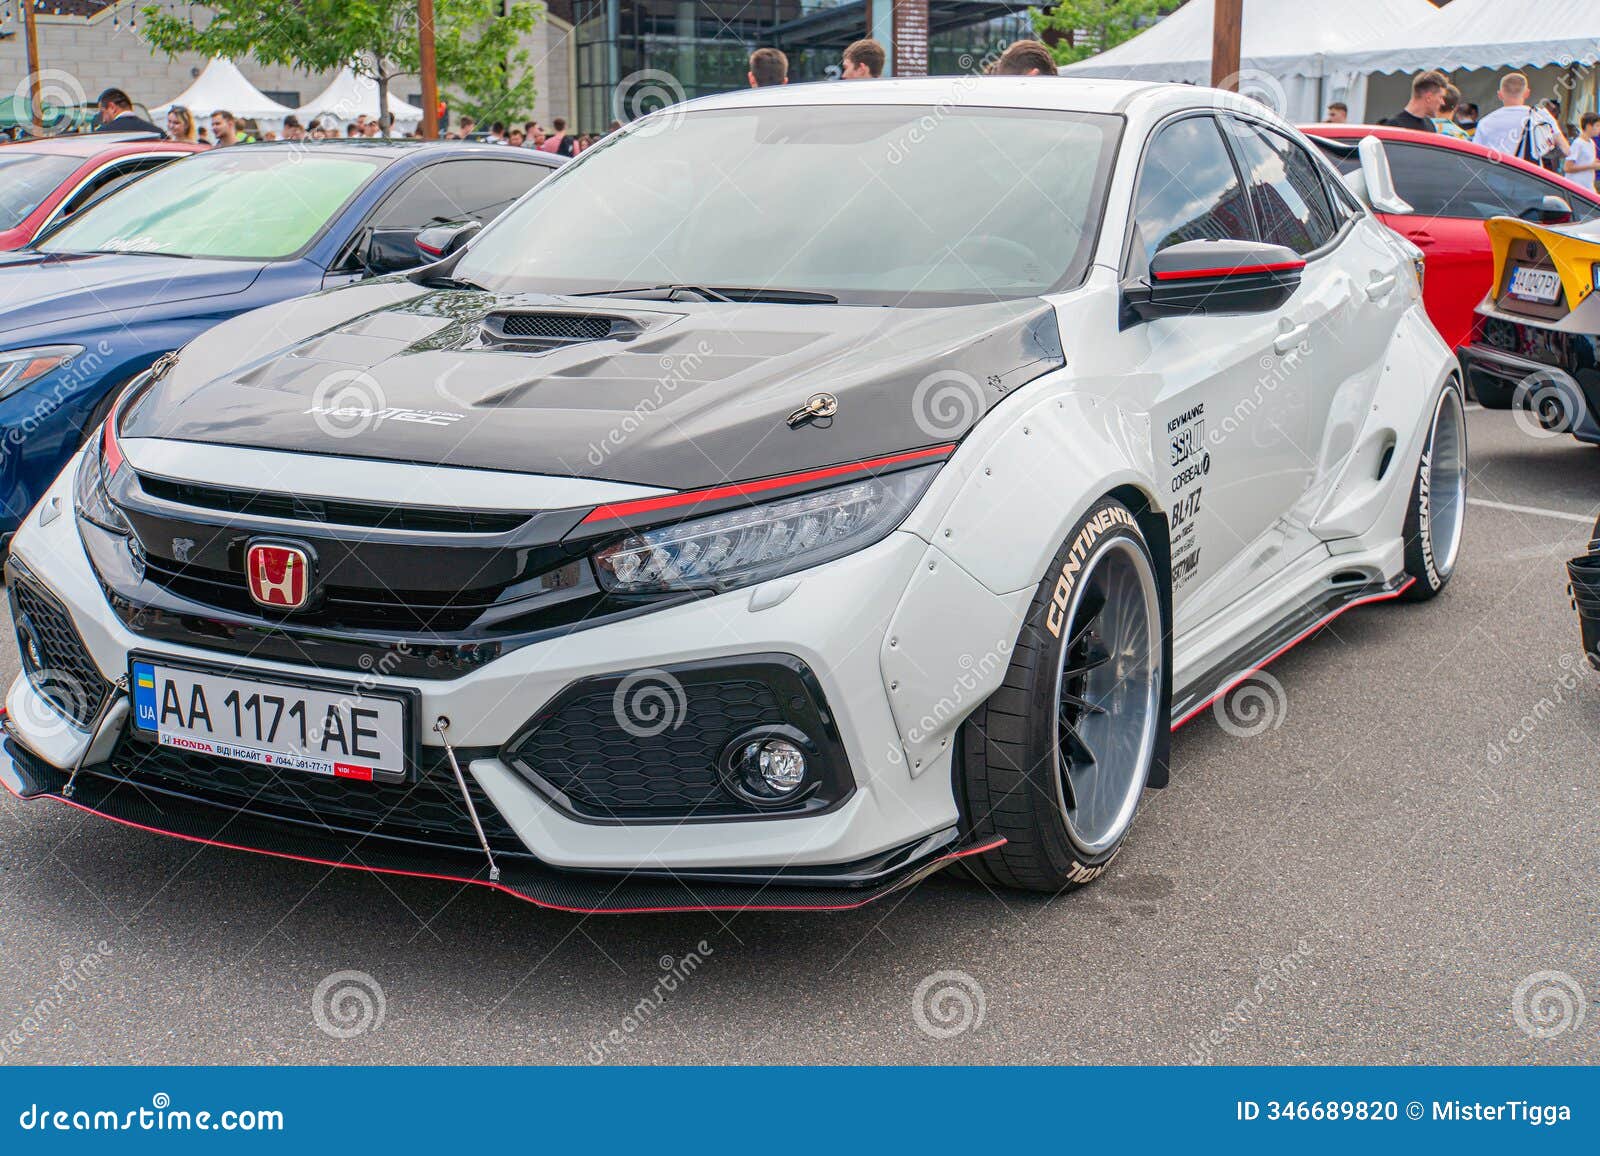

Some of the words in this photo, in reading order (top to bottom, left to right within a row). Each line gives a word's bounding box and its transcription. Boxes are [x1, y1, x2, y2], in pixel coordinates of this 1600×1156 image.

[1168, 403, 1204, 433] KEVMANNZ
[1170, 428, 1192, 467] SSR
[1172, 461, 1203, 493] CORBEAU
[1171, 487, 1202, 530] BLITZ
[139, 703, 156, 721] UA
[160, 679, 213, 732] AA
[224, 689, 307, 750] 1171
[321, 704, 381, 760] AE
[173, 738, 213, 752] HONDA
